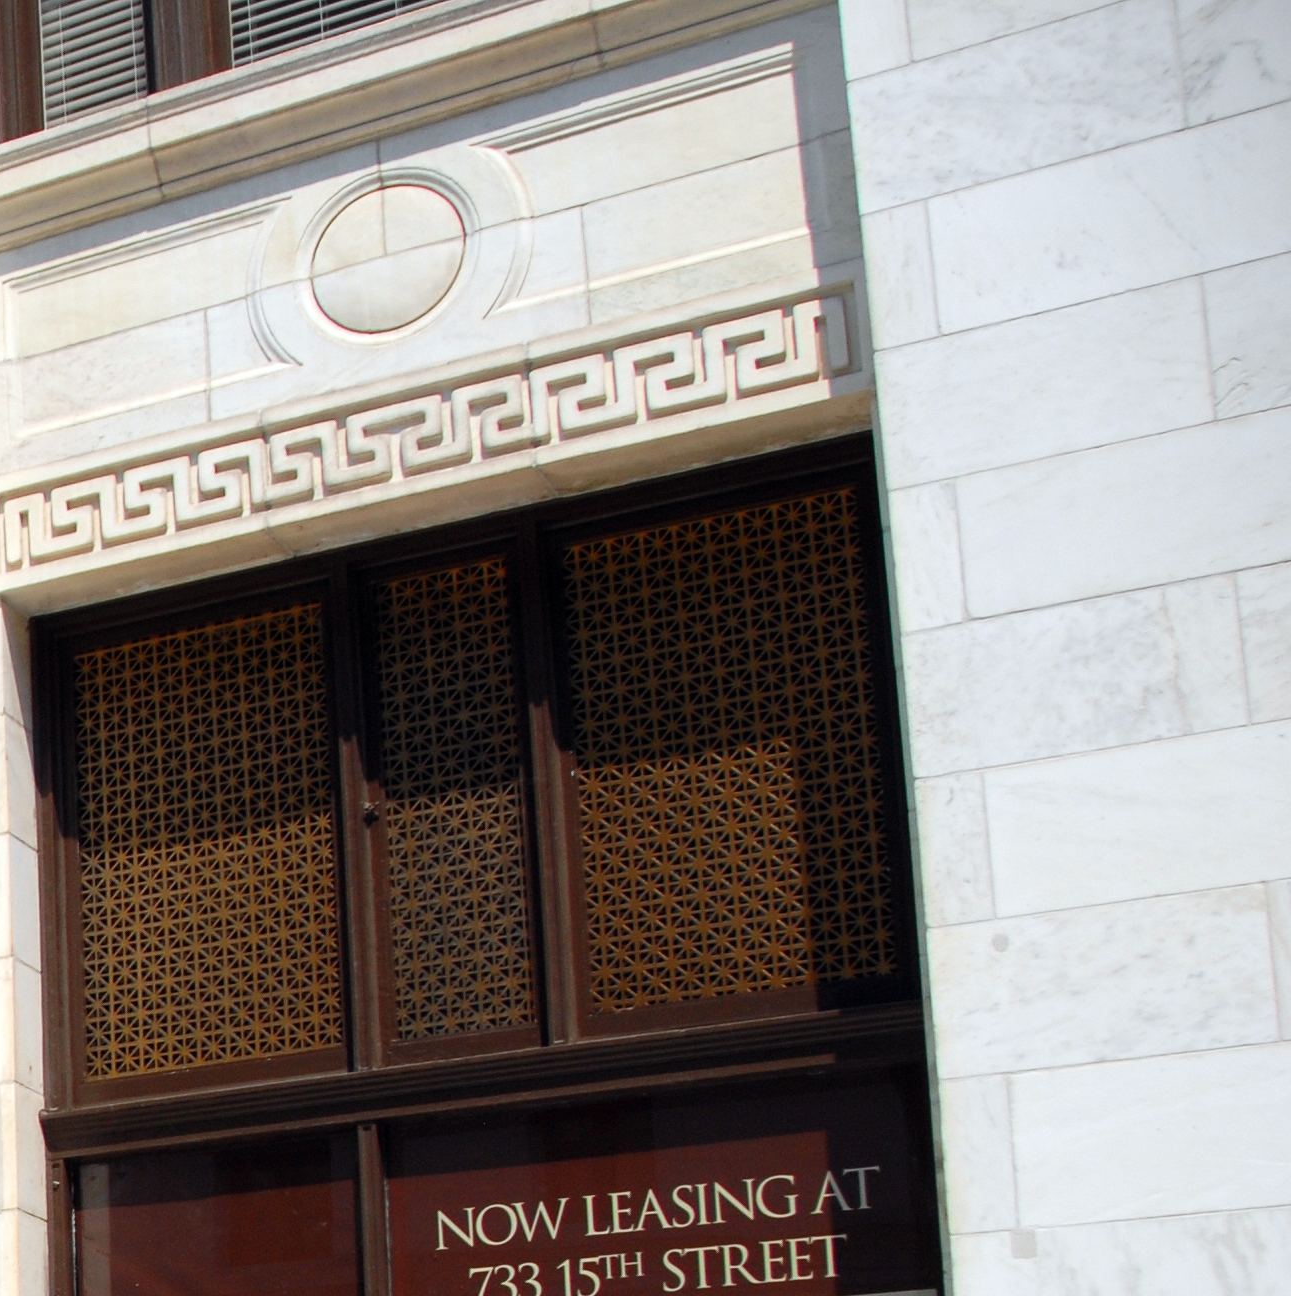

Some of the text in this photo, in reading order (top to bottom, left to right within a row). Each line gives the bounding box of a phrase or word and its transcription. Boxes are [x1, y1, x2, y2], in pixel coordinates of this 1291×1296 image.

[435, 1165, 880, 1251] NOW LEASING AT
[662, 1233, 847, 1292] STREET
